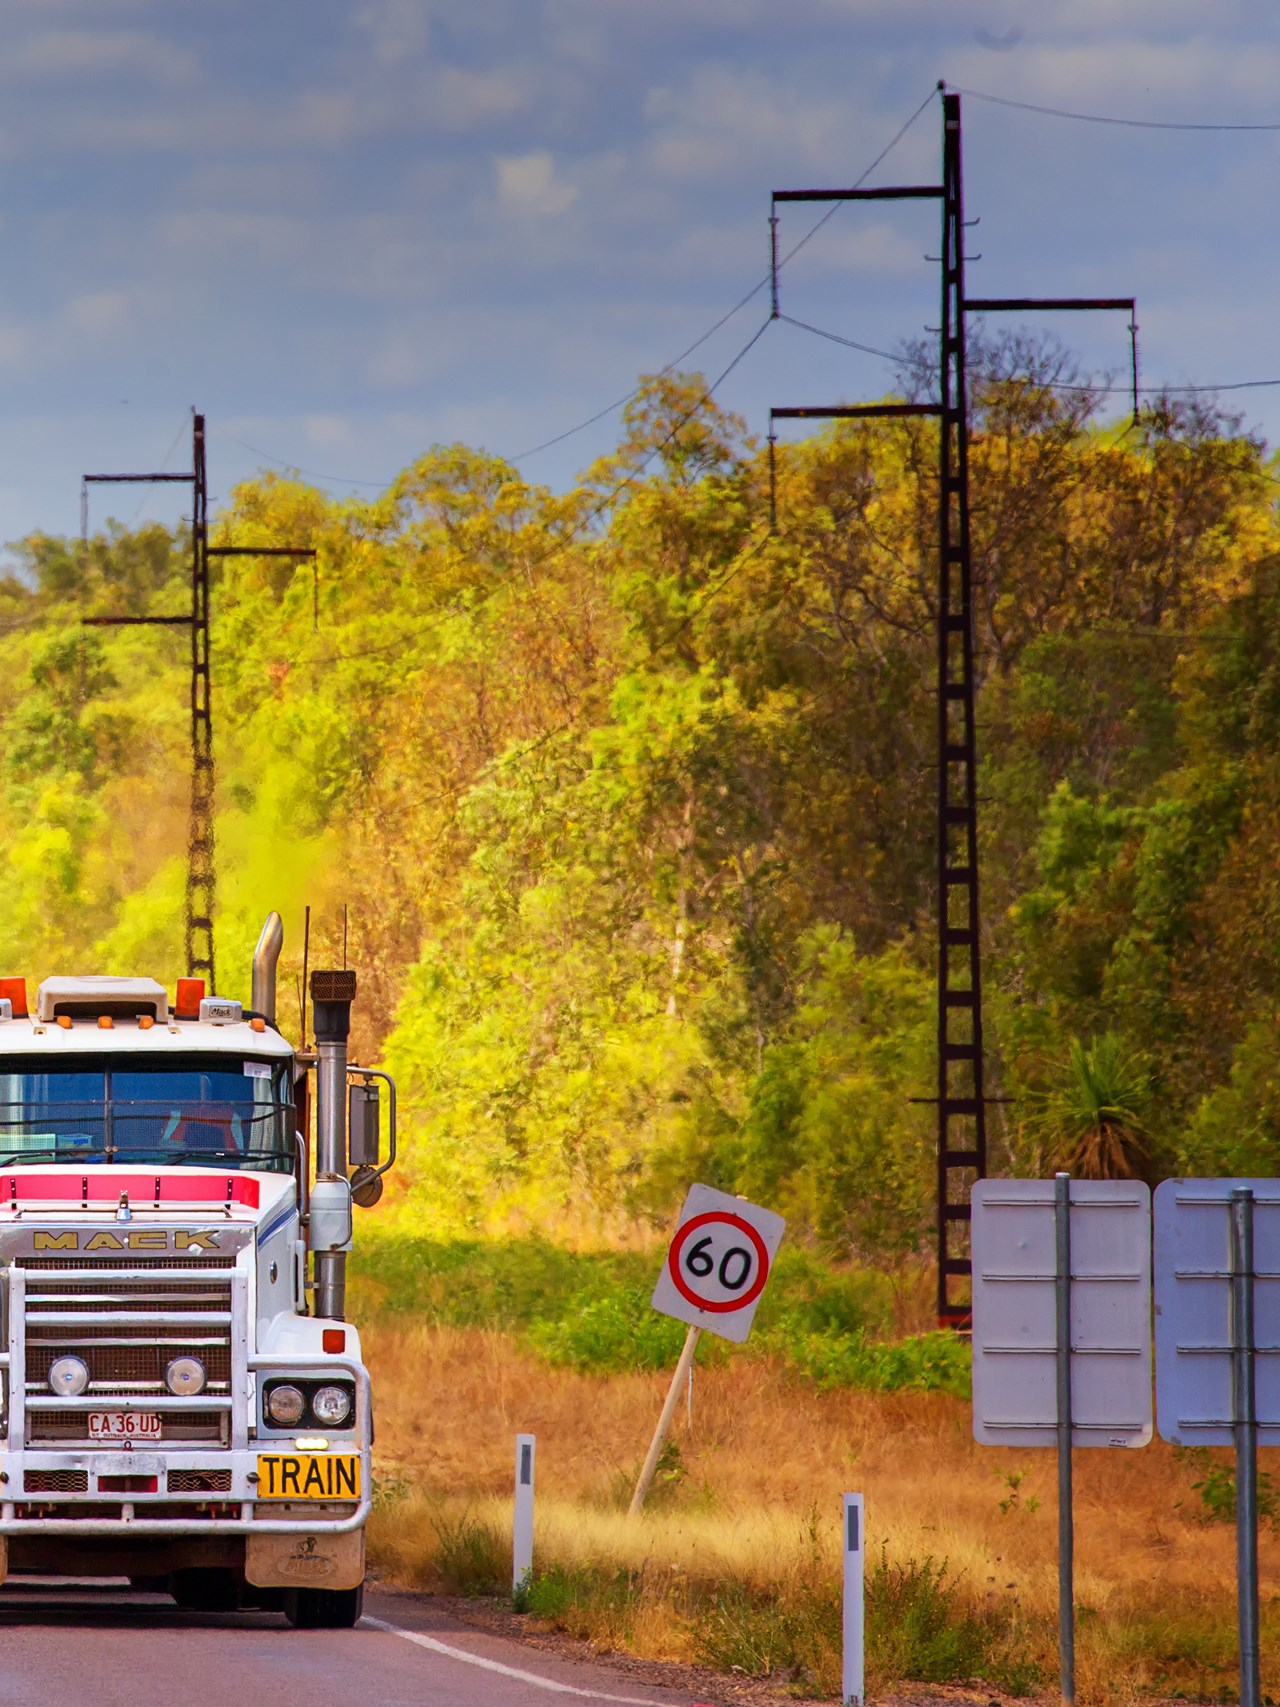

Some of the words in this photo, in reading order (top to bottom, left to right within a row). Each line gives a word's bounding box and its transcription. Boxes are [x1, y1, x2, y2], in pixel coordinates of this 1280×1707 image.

[211, 1008, 231, 1016] Mack
[33, 1231, 221, 1250] MACK
[686, 1236, 752, 1290] 60
[262, 1457, 356, 1495] TRAIN
